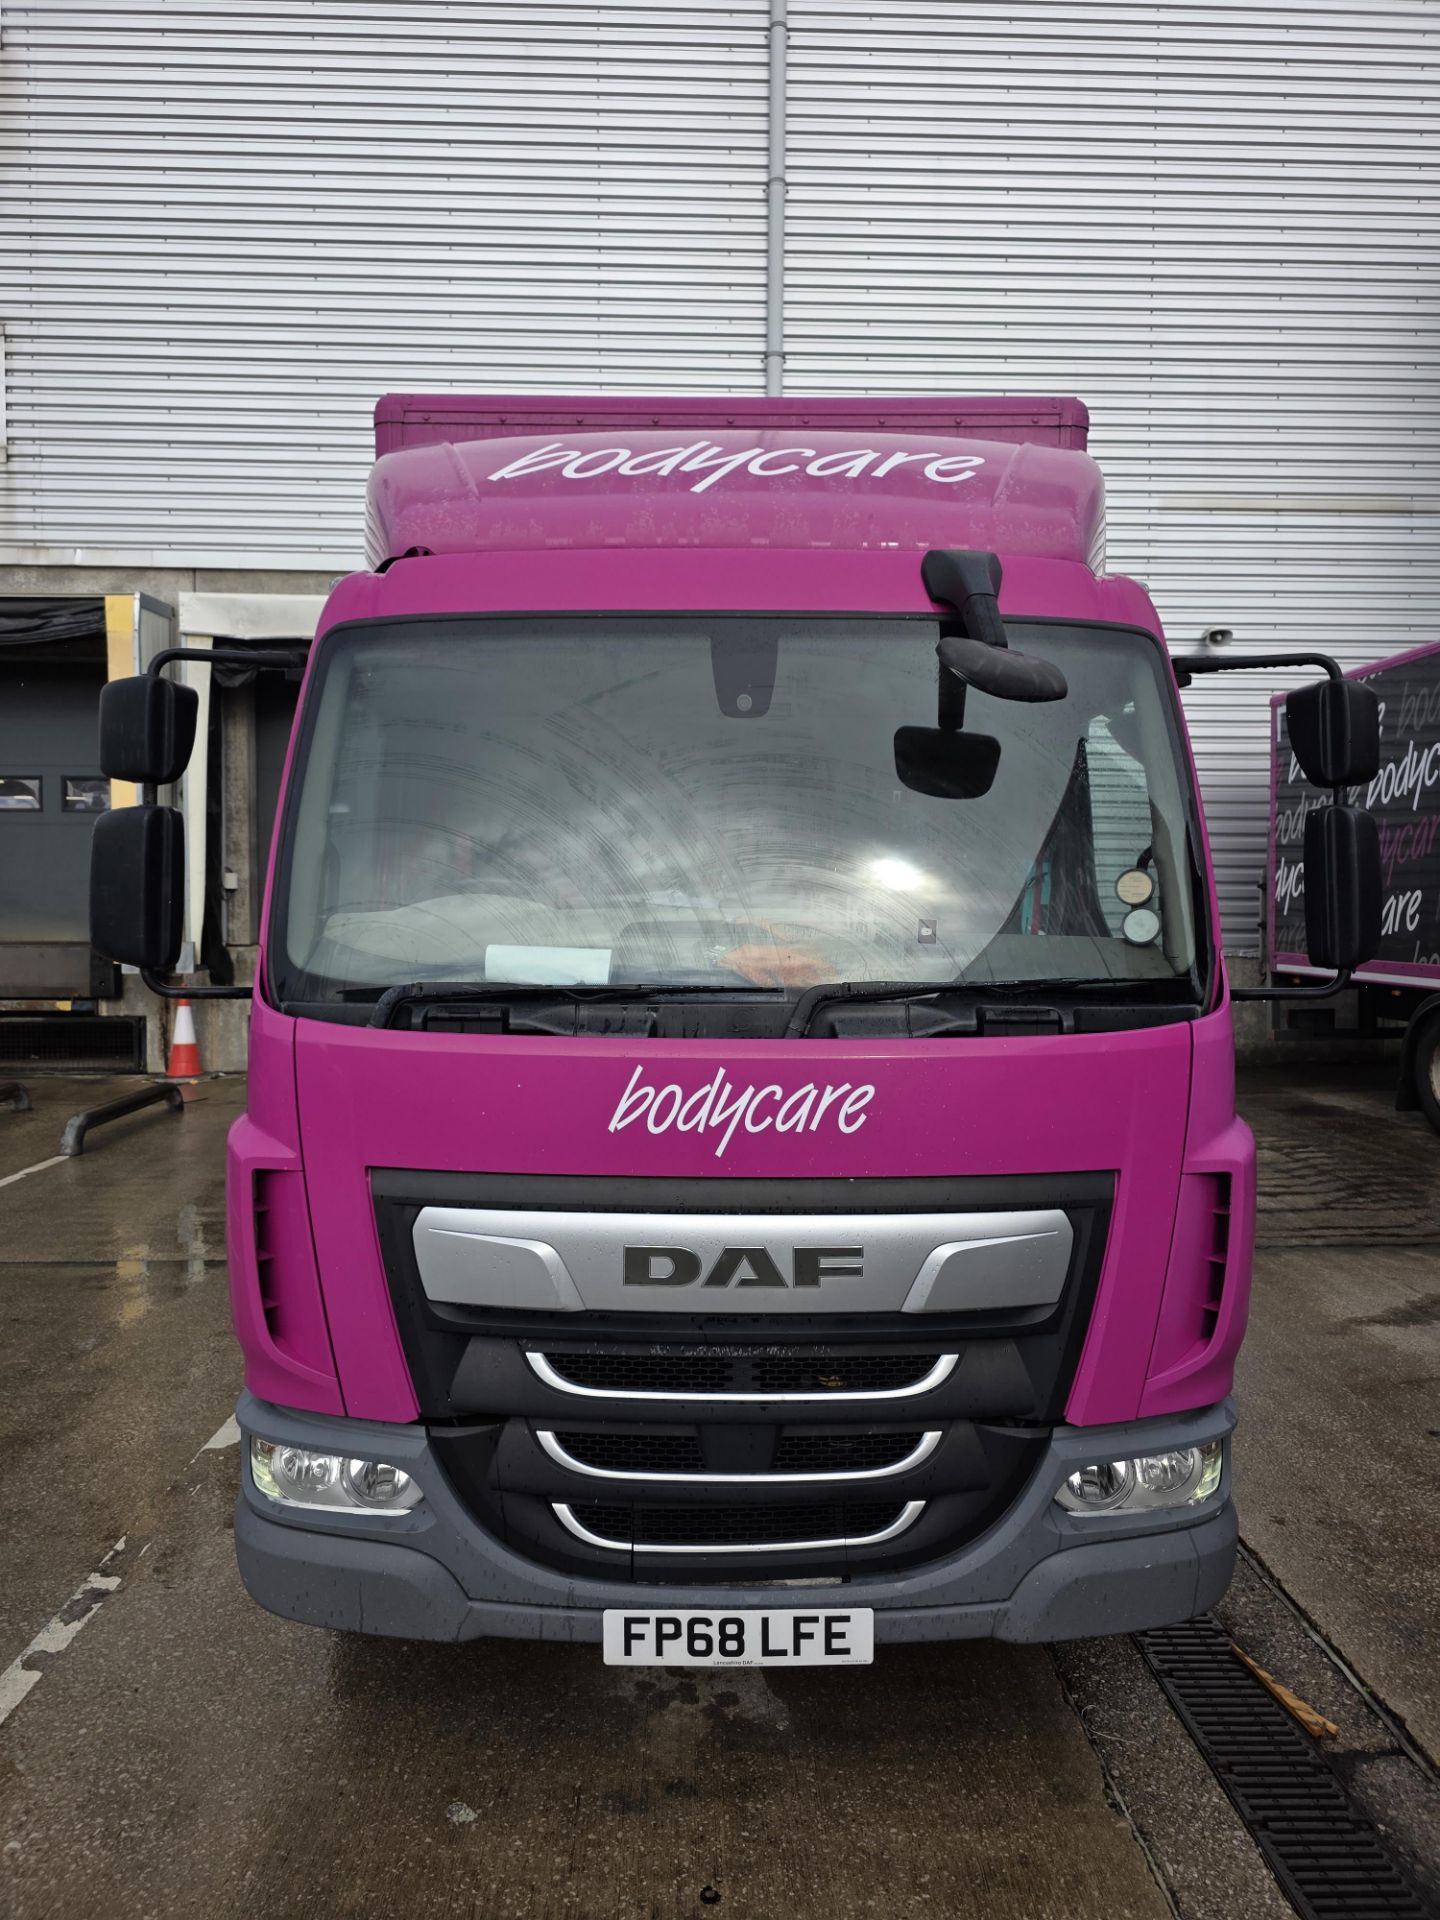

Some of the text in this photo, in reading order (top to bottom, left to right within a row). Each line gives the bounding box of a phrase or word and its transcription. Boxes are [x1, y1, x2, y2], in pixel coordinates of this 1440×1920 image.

[488, 440, 985, 493] bodycare
[608, 1064, 876, 1159] bodycare
[623, 1244, 864, 1288] DAF
[624, 1615, 851, 1658] FP68 LFE
